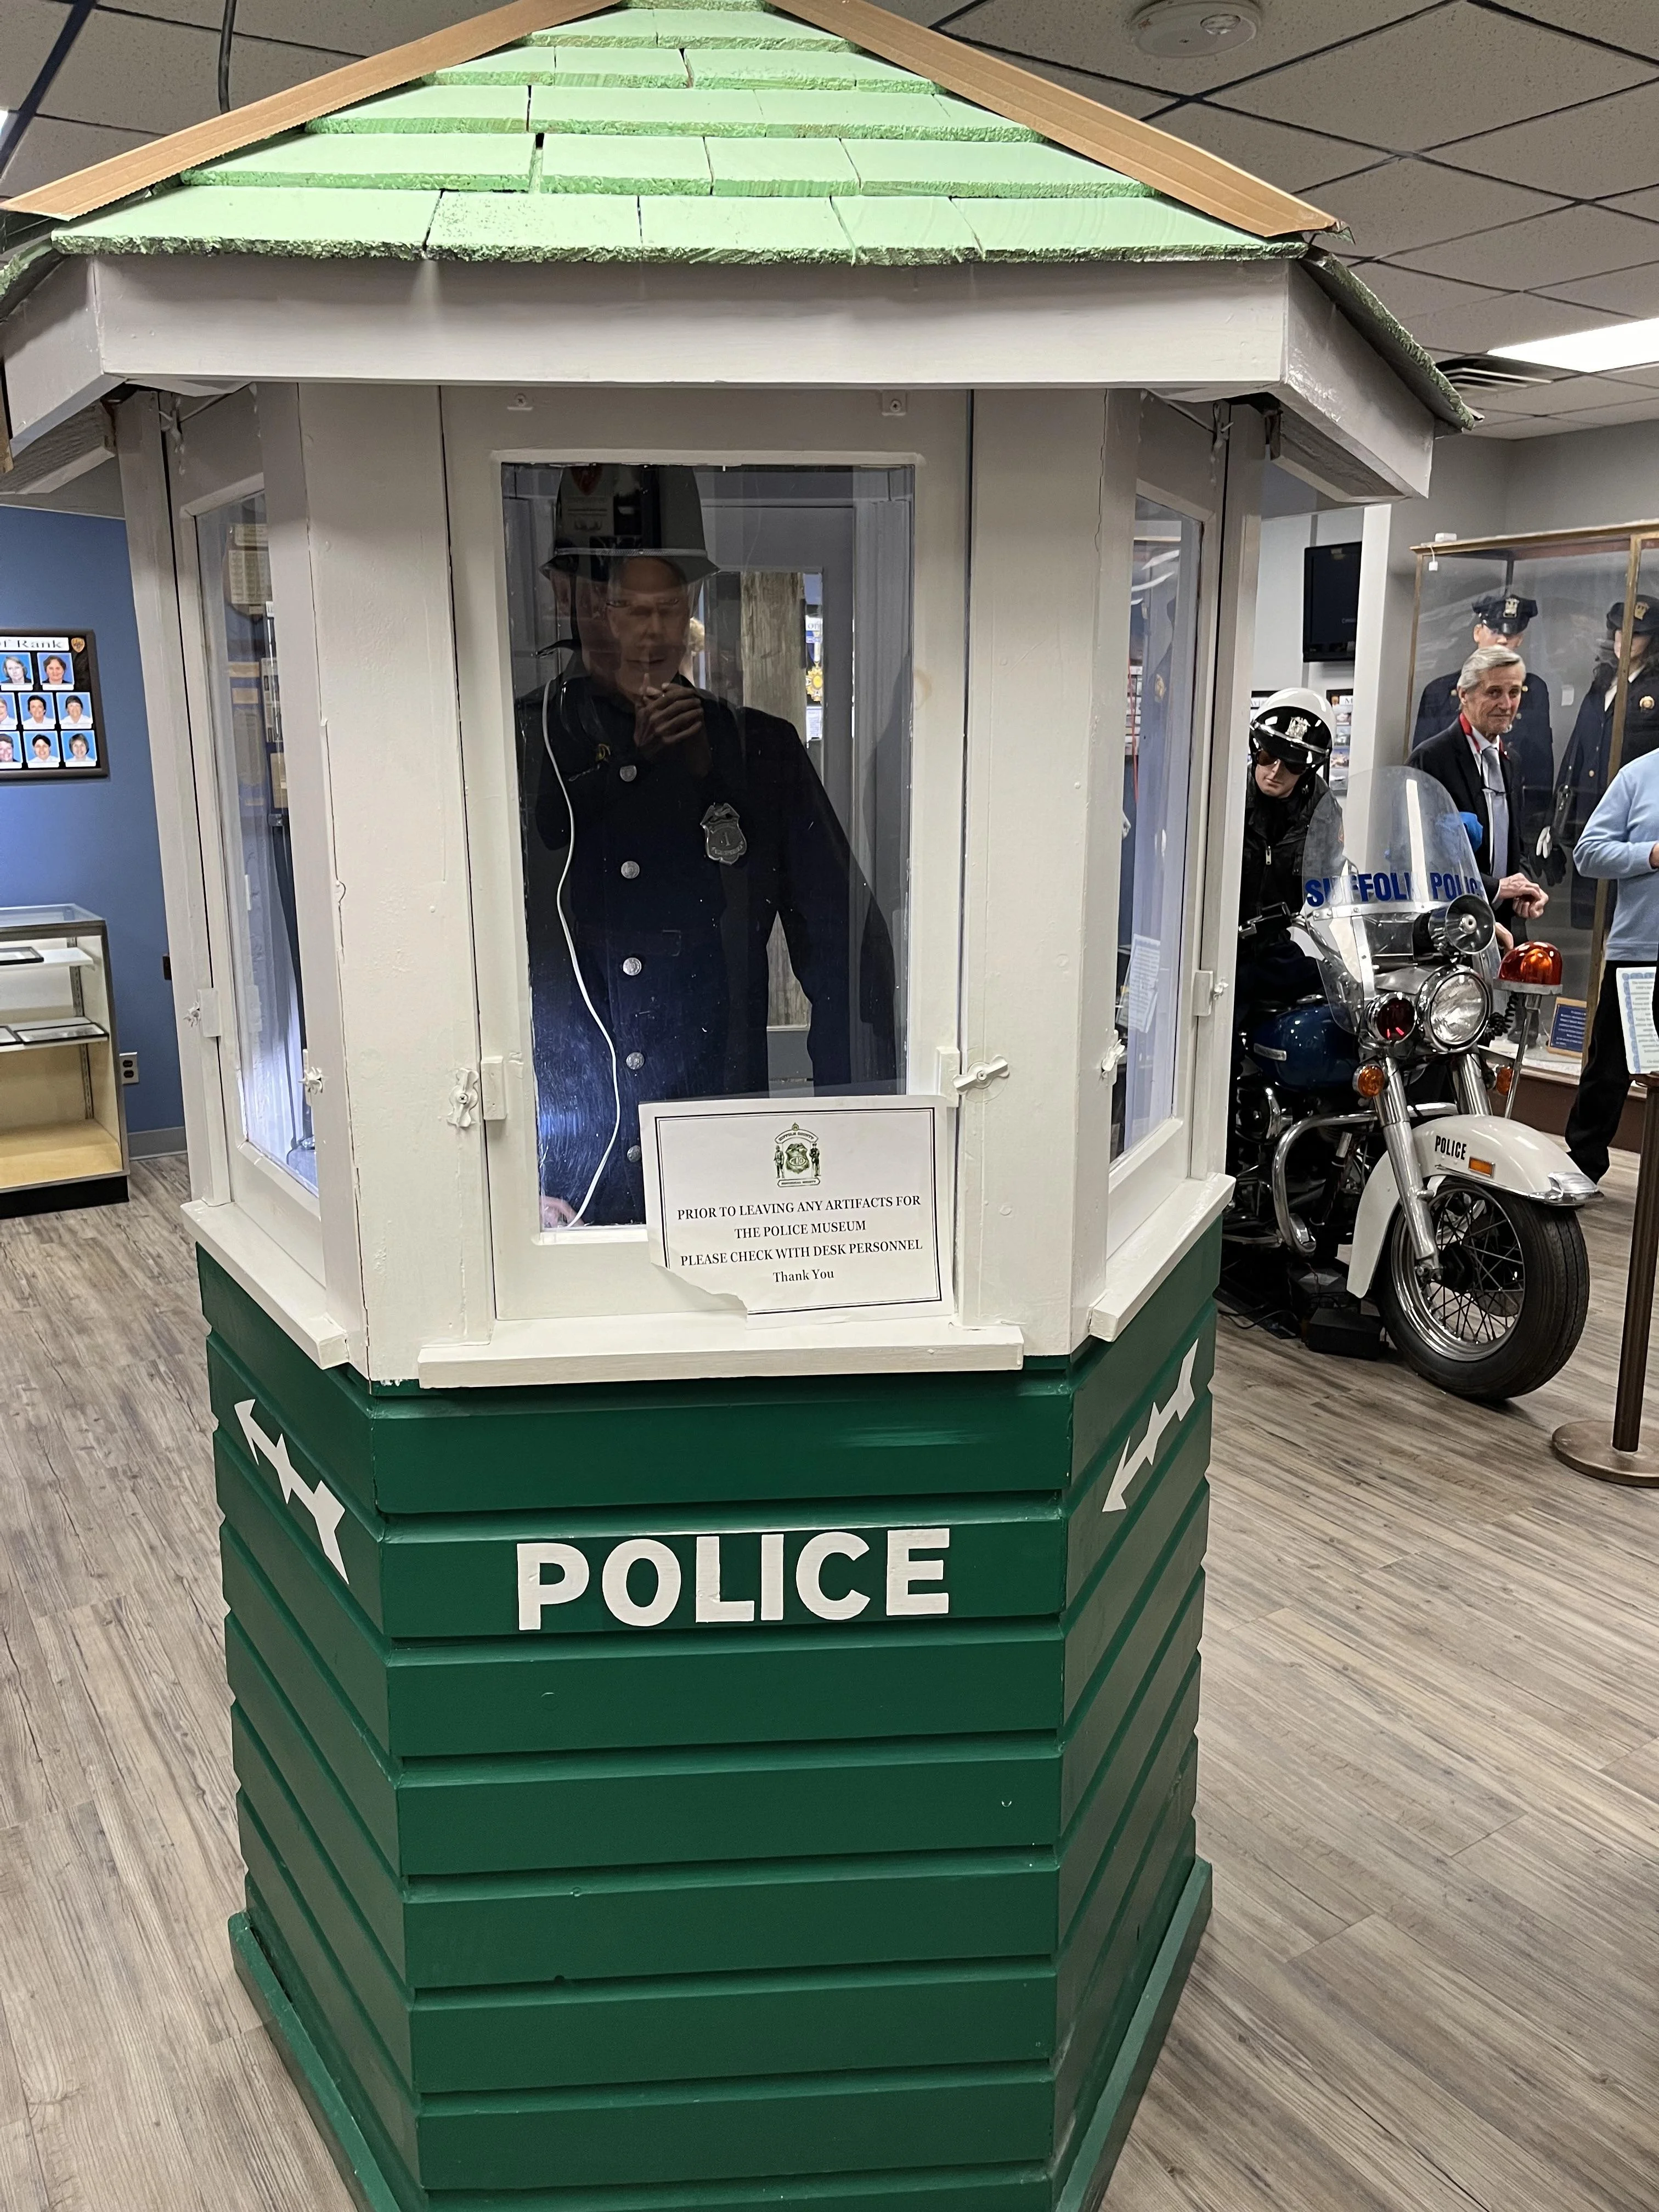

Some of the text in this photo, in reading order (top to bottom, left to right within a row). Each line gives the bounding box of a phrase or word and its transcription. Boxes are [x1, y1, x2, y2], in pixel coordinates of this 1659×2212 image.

[17, 640, 62, 648] Rank
[1434, 1135, 1468, 1161] POLICE
[678, 1195, 921, 1220] PRIOR TO LEAVING ANY ARTIFACTS FOR
[734, 1220, 866, 1239] THE POLICE MUSEUM
[680, 1239, 923, 1266] PLEASE CHECK WITH DESK PERSONNEL
[772, 1269, 834, 1283] Thank You
[516, 1528, 950, 1630] POLICE
